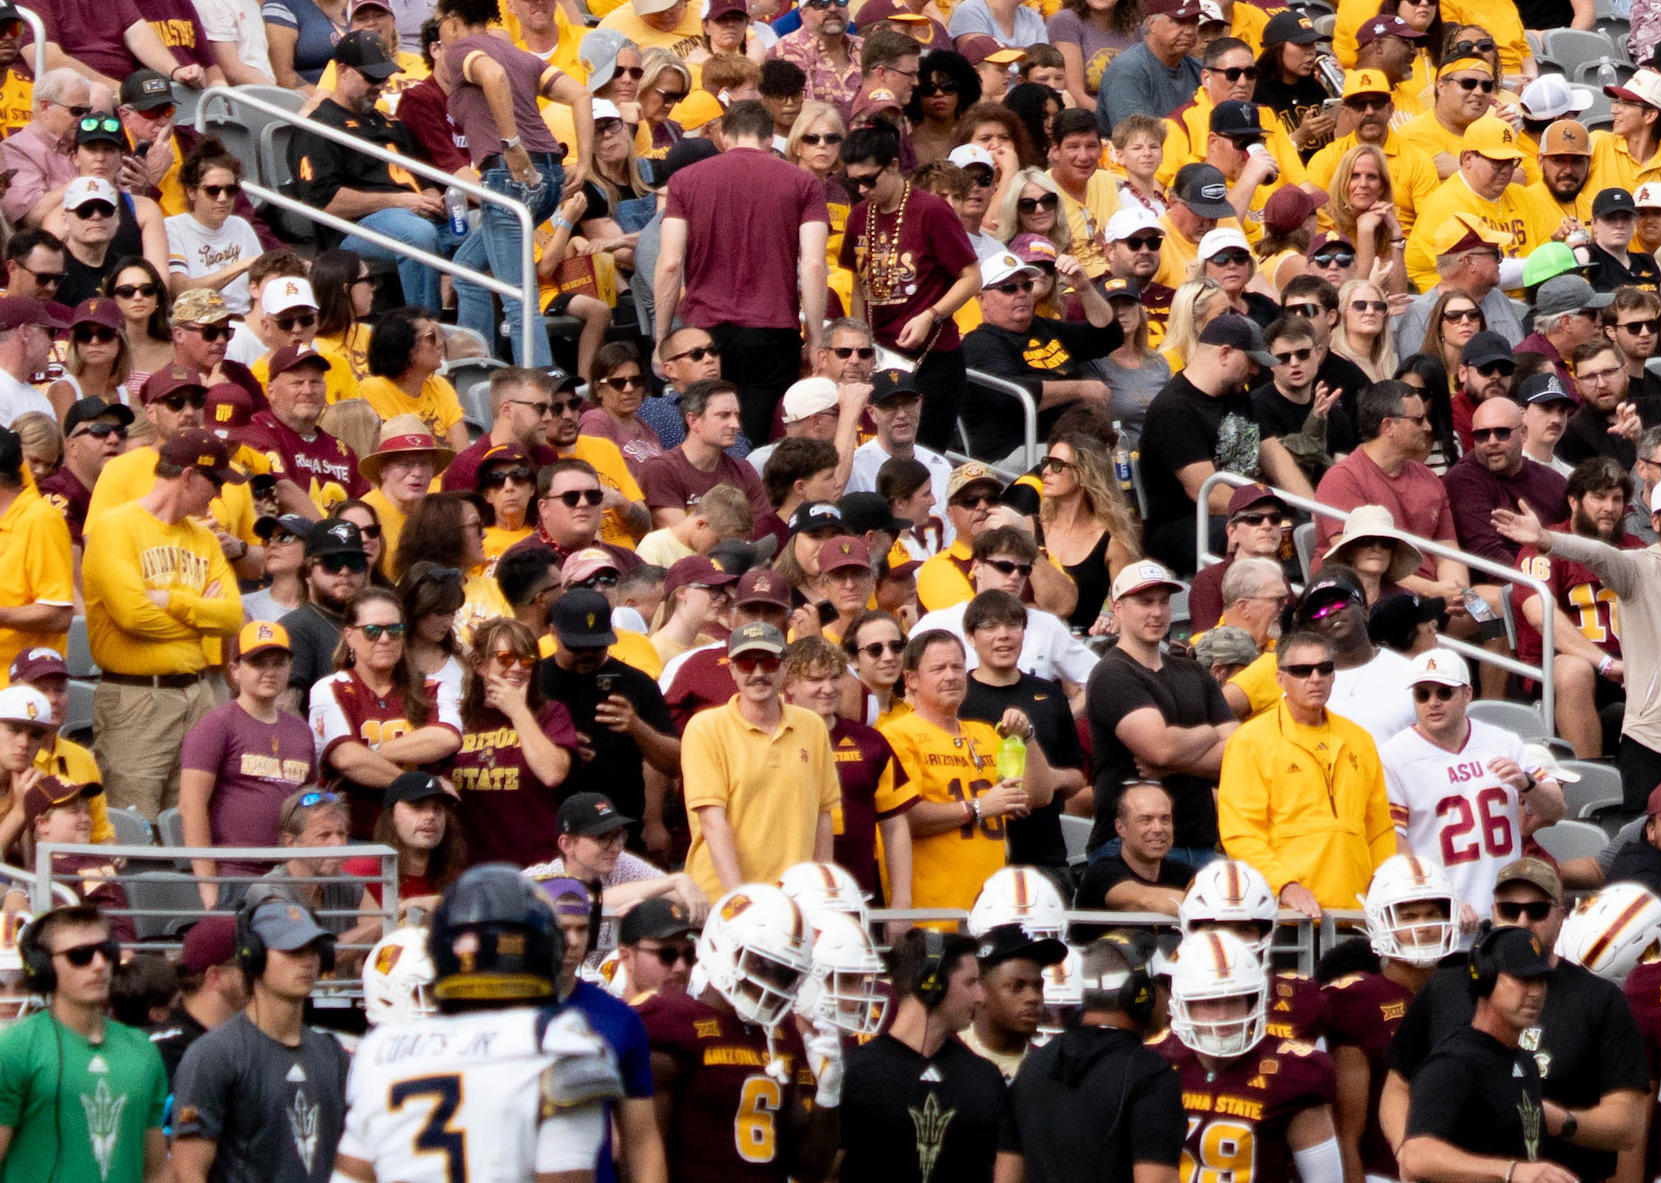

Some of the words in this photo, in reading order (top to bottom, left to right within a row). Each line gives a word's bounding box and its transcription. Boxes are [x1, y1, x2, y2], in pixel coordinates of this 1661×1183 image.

[196, 455, 216, 467] ASU
[1520, 558, 1552, 582] 16
[1447, 761, 1483, 784] ASU
[1437, 785, 1513, 866] 26
[736, 1076, 782, 1163] 6
[1216, 1095, 1263, 1121] STATE
[388, 1072, 467, 1183] 3
